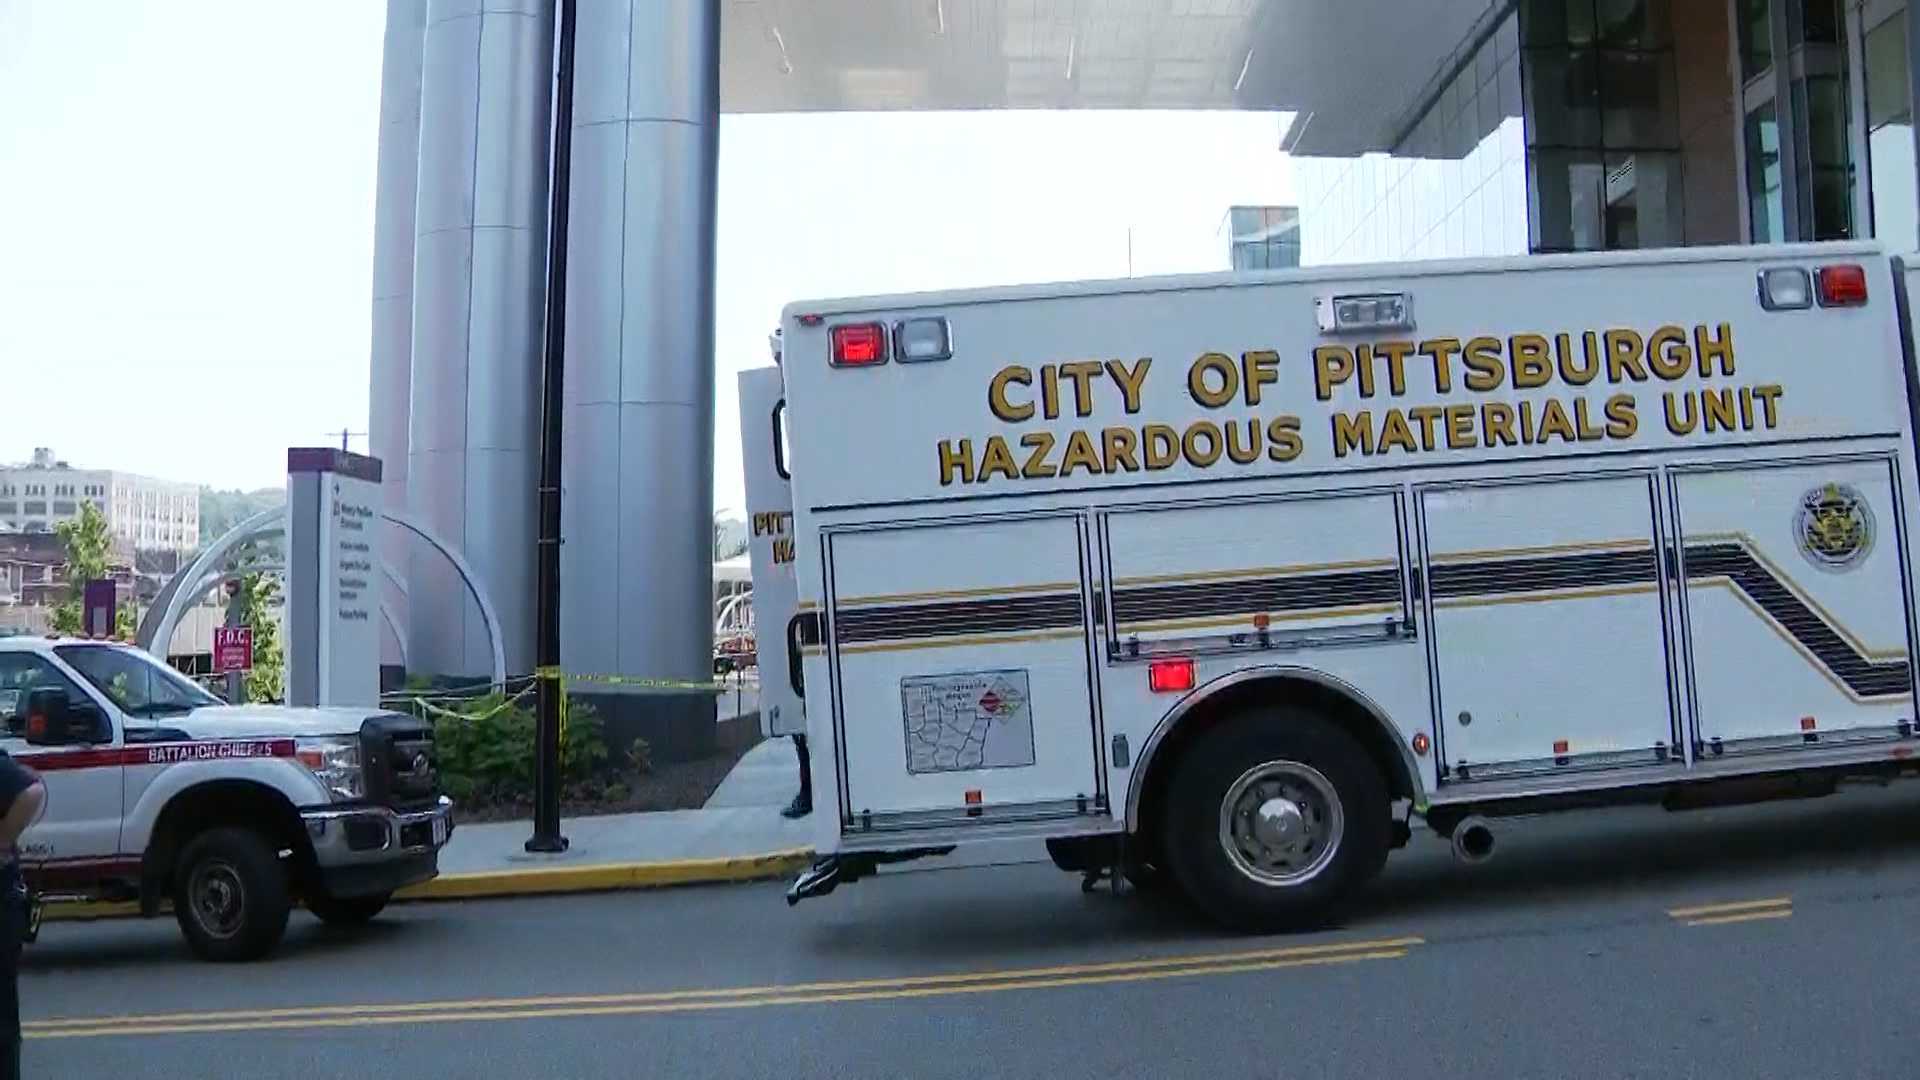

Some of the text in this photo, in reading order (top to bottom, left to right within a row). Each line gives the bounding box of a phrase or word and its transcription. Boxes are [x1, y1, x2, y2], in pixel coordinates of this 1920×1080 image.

[988, 322, 1735, 422] CITY OF PITTSBURGH
[938, 385, 1783, 486] HAZARDOUS MATERIALS UNIT
[148, 744, 217, 762] BATTALION
[219, 743, 255, 757] CHIEF
